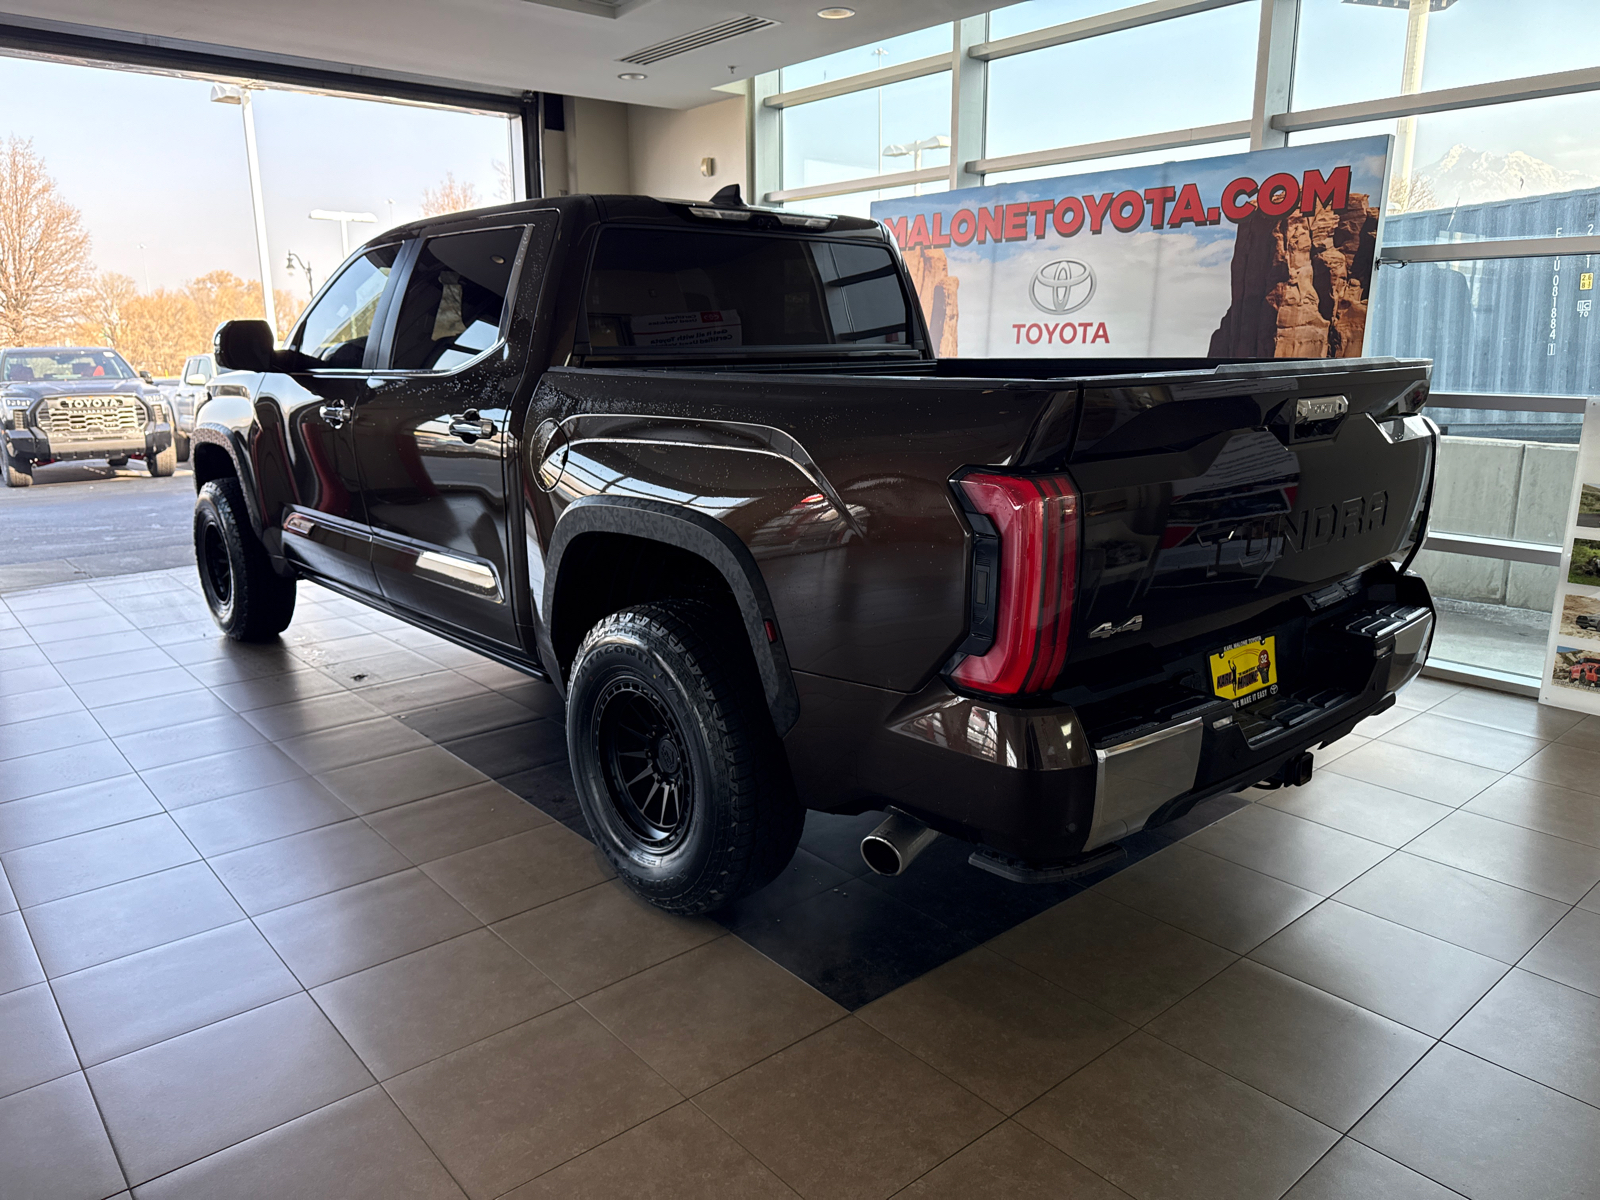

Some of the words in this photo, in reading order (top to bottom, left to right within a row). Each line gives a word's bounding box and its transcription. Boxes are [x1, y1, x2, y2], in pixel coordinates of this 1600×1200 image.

[885, 165, 1351, 249] MALONETOYOTA.COM
[1012, 322, 1110, 345] TOYOTA
[66, 399, 118, 408] TOYOTA
[1197, 490, 1388, 577] TUNDRA
[1260, 654, 1268, 664] 32
[1232, 700, 1240, 709] WE
[1240, 695, 1252, 706] MAKE
[1256, 688, 1268, 700] EASY
